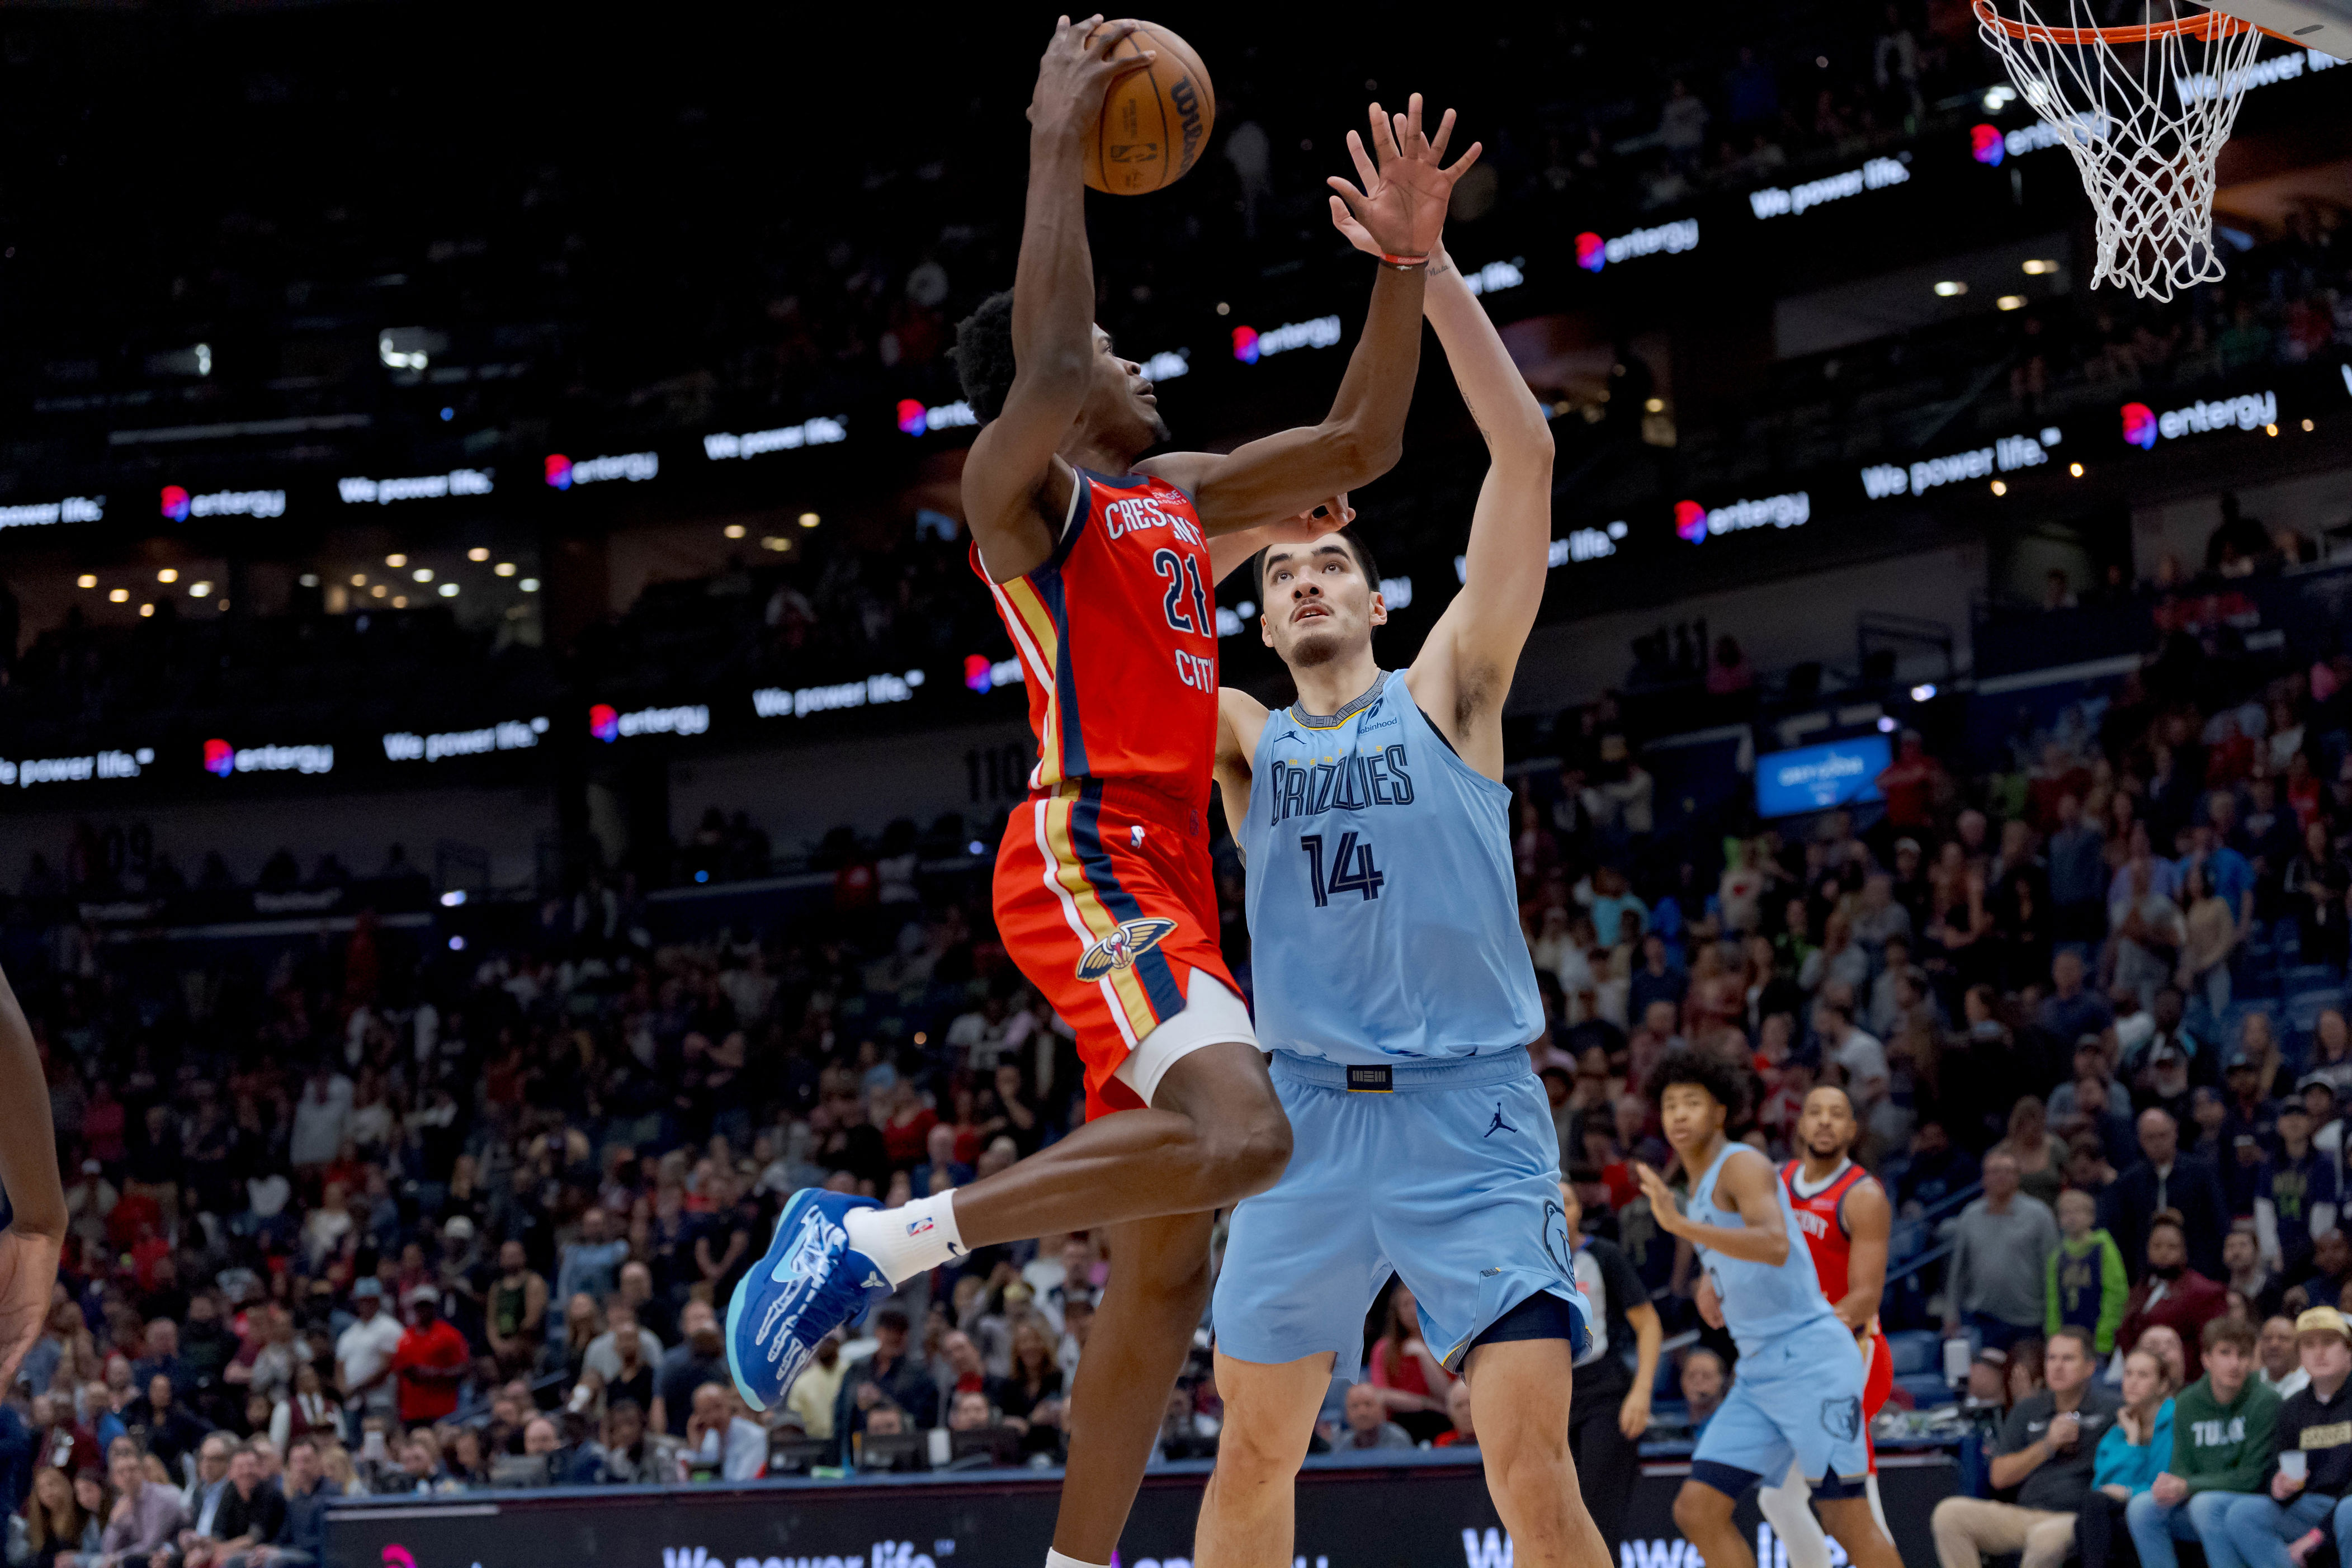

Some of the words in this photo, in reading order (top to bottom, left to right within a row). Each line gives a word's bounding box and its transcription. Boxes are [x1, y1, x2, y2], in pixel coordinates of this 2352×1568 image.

[2159, 390, 2277, 440] entergy
[1861, 463, 1908, 500] We
[1909, 447, 1995, 497] power
[1105, 498, 1207, 554] CRESNT
[1707, 491, 1810, 536] entergy
[1153, 547, 1212, 638] 21
[1175, 649, 1213, 694] CITY
[20, 756, 95, 788] power
[1271, 744, 1415, 826] GRIZZLIES
[1301, 832, 1385, 908] 14
